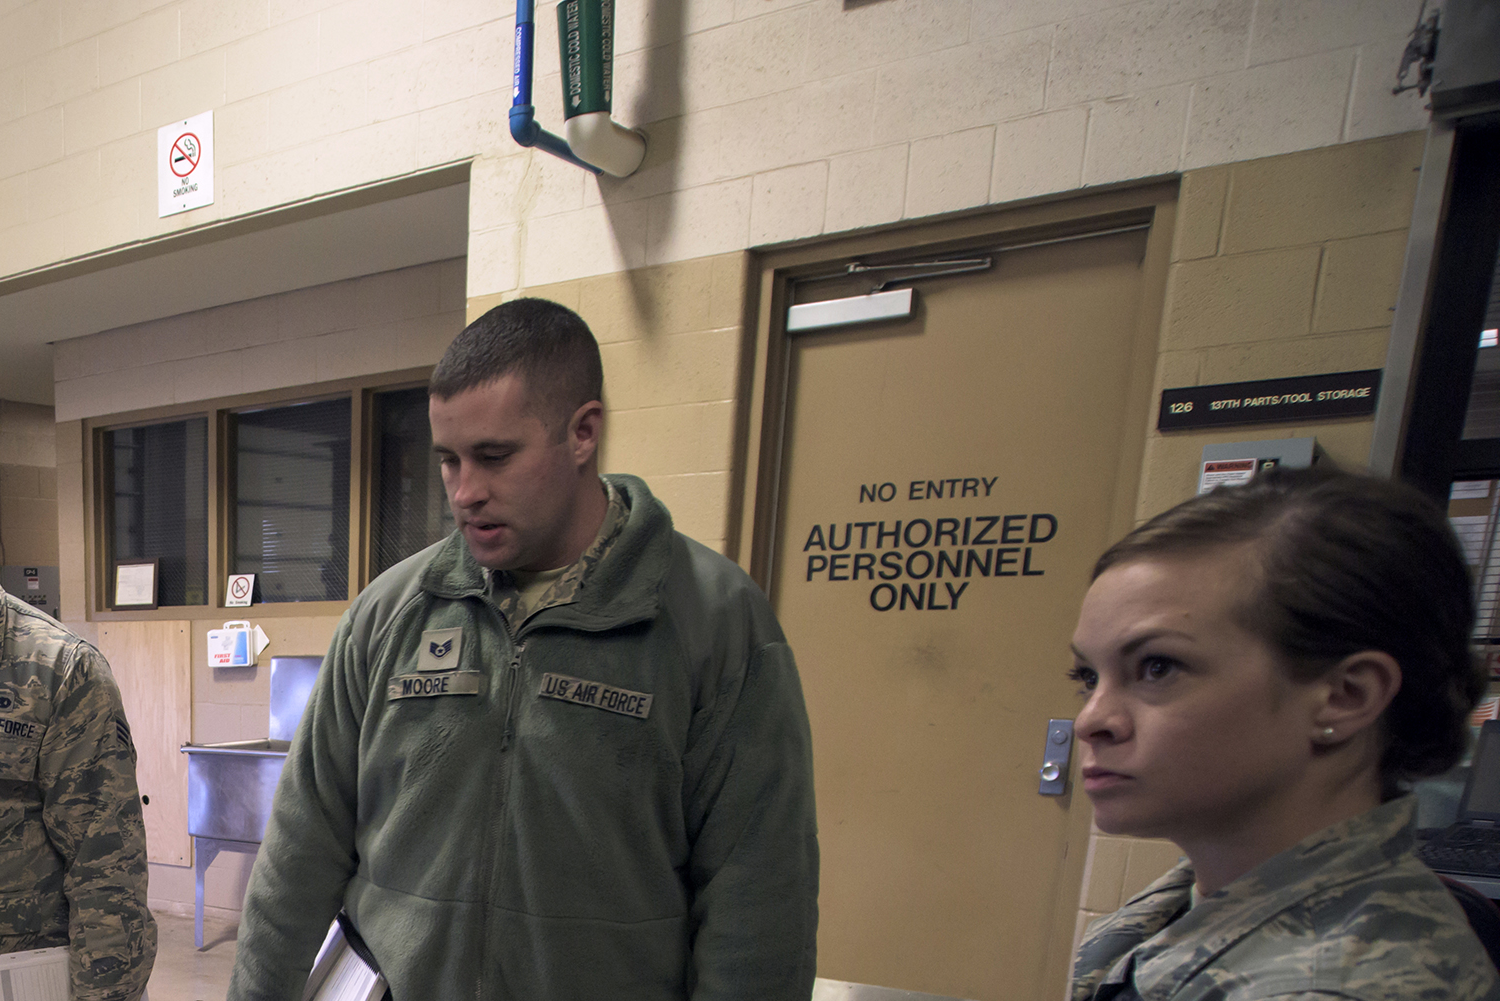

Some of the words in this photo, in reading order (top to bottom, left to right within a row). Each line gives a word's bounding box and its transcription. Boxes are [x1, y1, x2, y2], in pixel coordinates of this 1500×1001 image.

[514, 26, 522, 75] COMPRESSED
[568, 30, 581, 53] COLD
[602, 38, 611, 61] COLD
[568, 53, 582, 96] DOMESTIC
[603, 63, 611, 91] WATER
[173, 183, 198, 198] SMOKING
[181, 177, 190, 185] NO
[1169, 402, 1193, 413] 126
[1209, 398, 1240, 411] 137TH
[1243, 393, 1313, 407] PARTS/TOOL
[1317, 387, 1372, 401] STORAGE
[859, 482, 897, 503] NO
[908, 476, 999, 500] ENTRY
[803, 513, 1059, 552] AUTHORIZED
[806, 547, 1045, 582] PERSONNEL
[870, 582, 970, 612] ONLY
[402, 676, 450, 695] MOORE
[571, 683, 597, 704] AIR
[599, 688, 647, 714] FORCE
